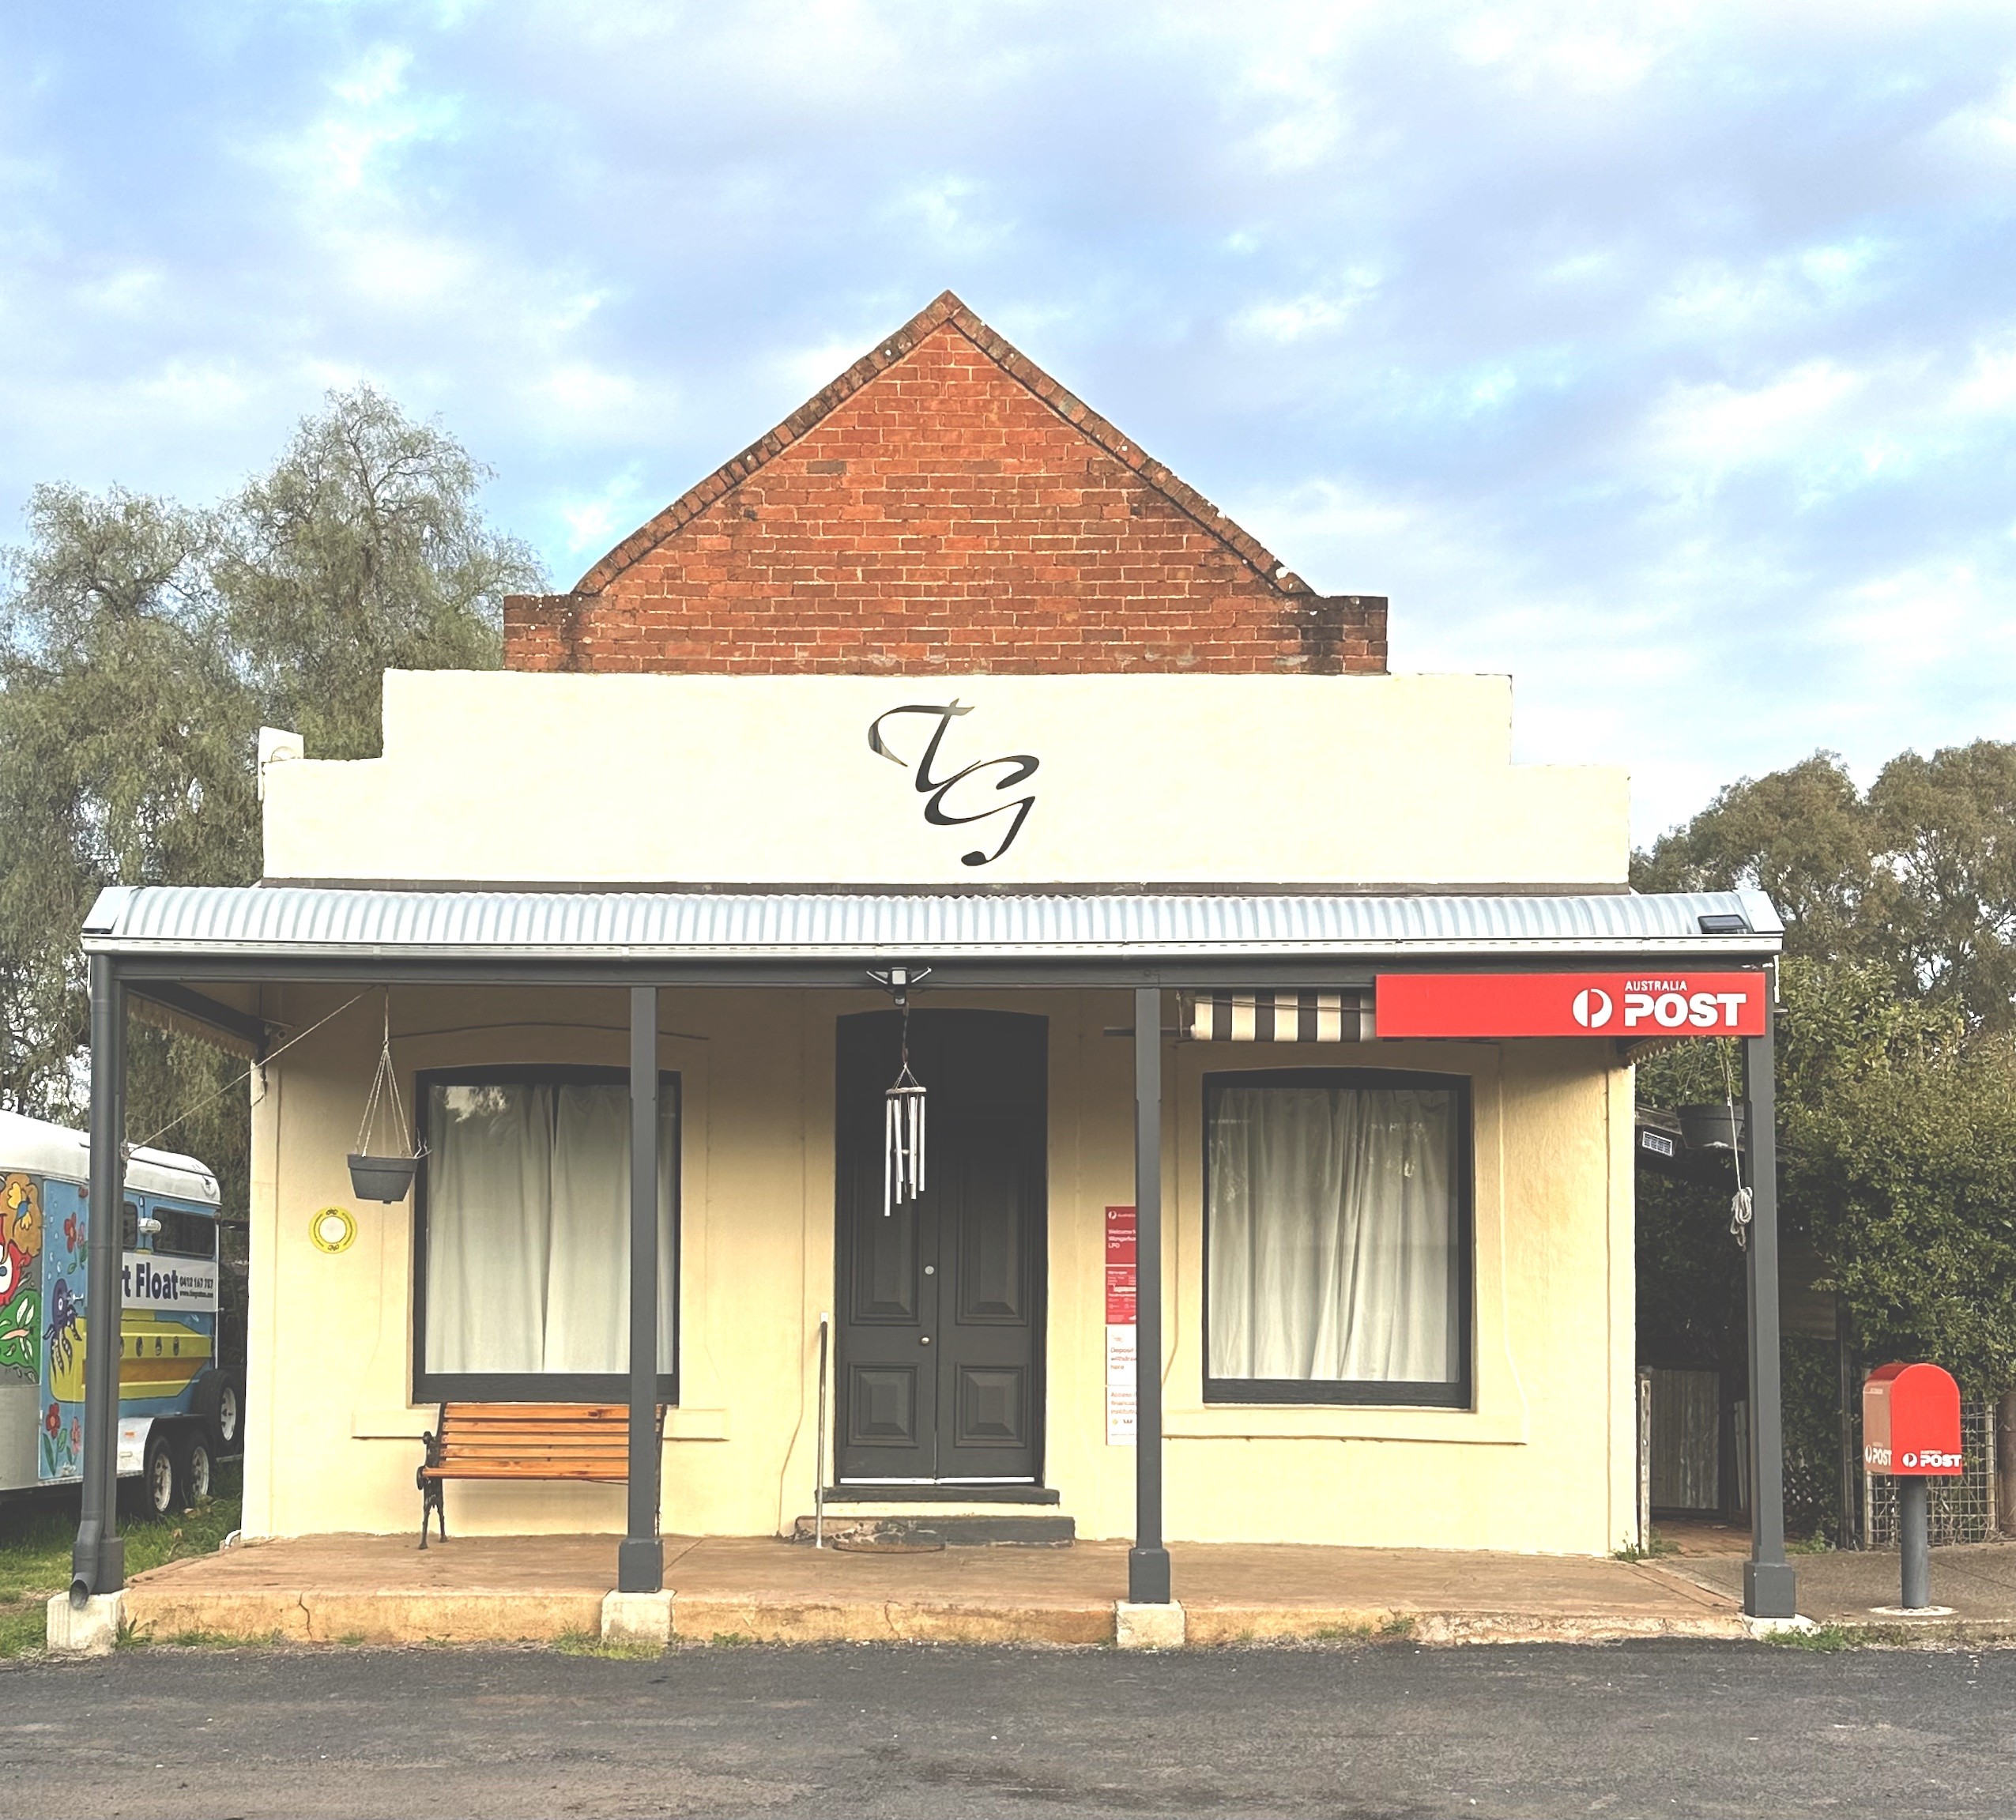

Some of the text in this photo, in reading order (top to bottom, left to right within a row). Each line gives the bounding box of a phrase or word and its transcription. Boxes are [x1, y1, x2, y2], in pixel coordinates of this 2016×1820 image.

[1625, 980, 1688, 991] AUSTRALIA
[1625, 993, 1747, 1027] POST
[136, 1262, 179, 1300] Float
[1872, 1448, 1892, 1466] POST
[1920, 1454, 1961, 1468] POST
